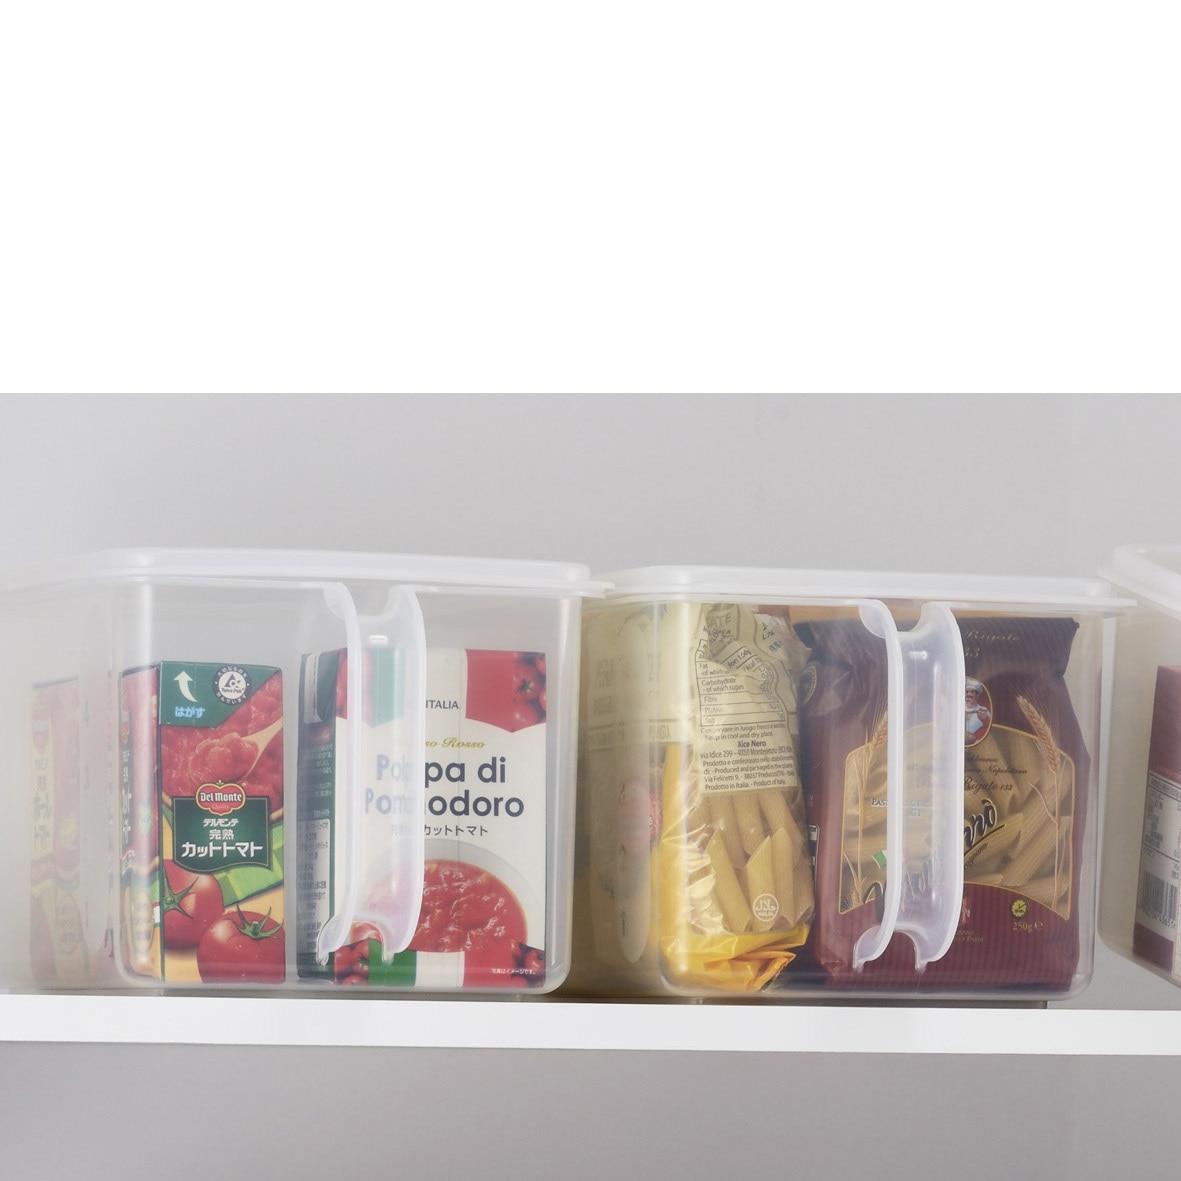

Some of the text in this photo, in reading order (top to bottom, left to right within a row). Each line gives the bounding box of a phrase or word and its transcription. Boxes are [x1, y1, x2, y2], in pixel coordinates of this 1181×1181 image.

[174, 706, 205, 718] はがす
[478, 756, 506, 783] di
[200, 792, 242, 802] Del Monte
[203, 818, 239, 827] デルモンテ
[209, 829, 234, 840] 完熟
[181, 841, 263, 858] カットトマト
[1012, 921, 1033, 933] 250g
